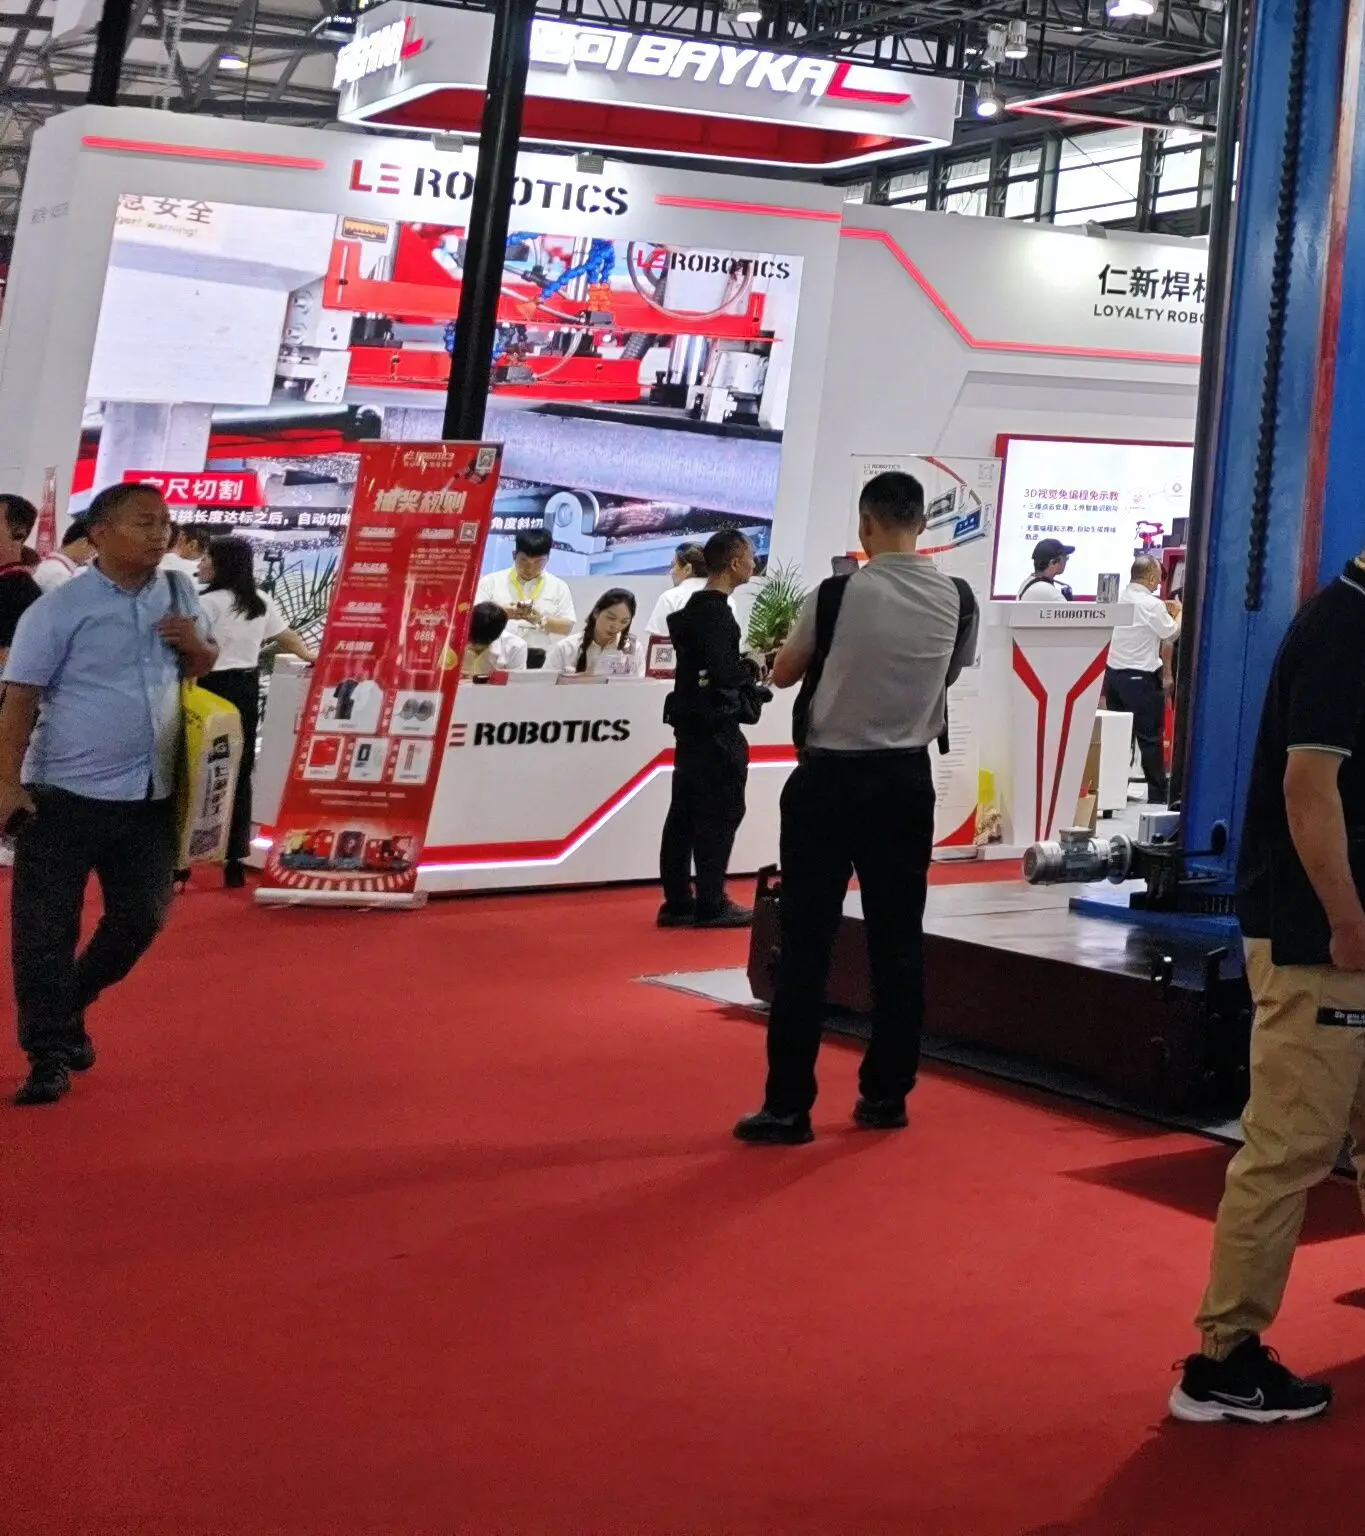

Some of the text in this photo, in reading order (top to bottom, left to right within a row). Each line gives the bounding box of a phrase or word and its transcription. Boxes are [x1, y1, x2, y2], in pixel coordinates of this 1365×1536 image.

[626, 34, 912, 105] BAYKAL
[412, 166, 629, 217] ROOTICS
[669, 252, 791, 280] ROBOTICS
[1093, 303, 1164, 322] LOYALTY
[1054, 609, 1106, 620] ROBOTICS
[473, 718, 631, 747] ROBOTICS
